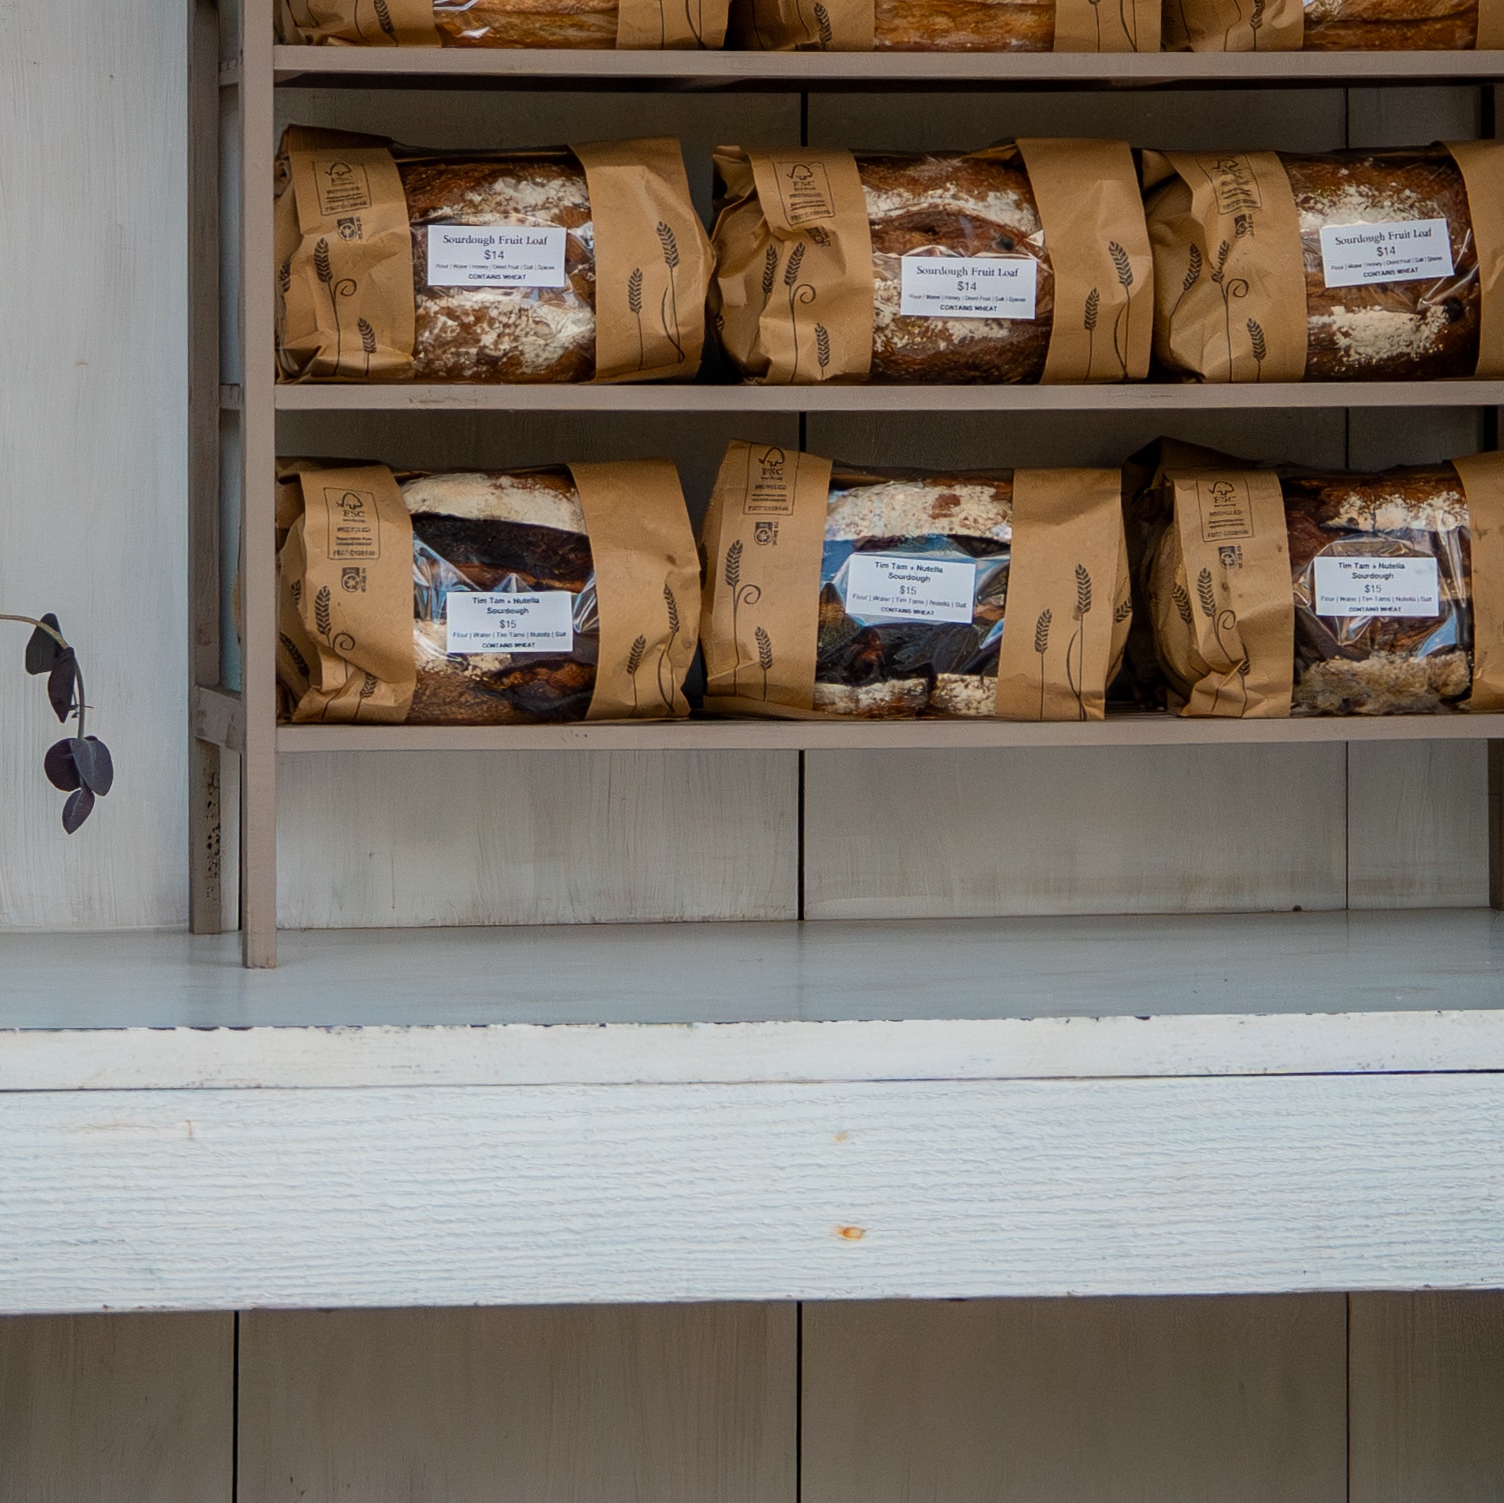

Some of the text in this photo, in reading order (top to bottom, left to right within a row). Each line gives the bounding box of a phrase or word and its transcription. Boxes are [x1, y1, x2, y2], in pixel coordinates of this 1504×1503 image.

[444, 235, 548, 245] Sourdough Fruit Loaf
[1335, 228, 1432, 245] Sourdough Fruit Loaf
[484, 249, 504, 260] $14
[1377, 246, 1396, 257] $14
[917, 266, 1019, 278] Sourdough Fruit Loaf
[957, 281, 977, 291] $14
[343, 510, 365, 518] FSC
[917, 565, 943, 573] Nutella
[889, 573, 931, 582] Sourdough
[1352, 572, 1394, 580] Sourdough
[899, 585, 917, 594] $15
[1365, 584, 1382, 593] $15
[487, 607, 529, 615] Sourdough
[499, 620, 516, 629] $15
